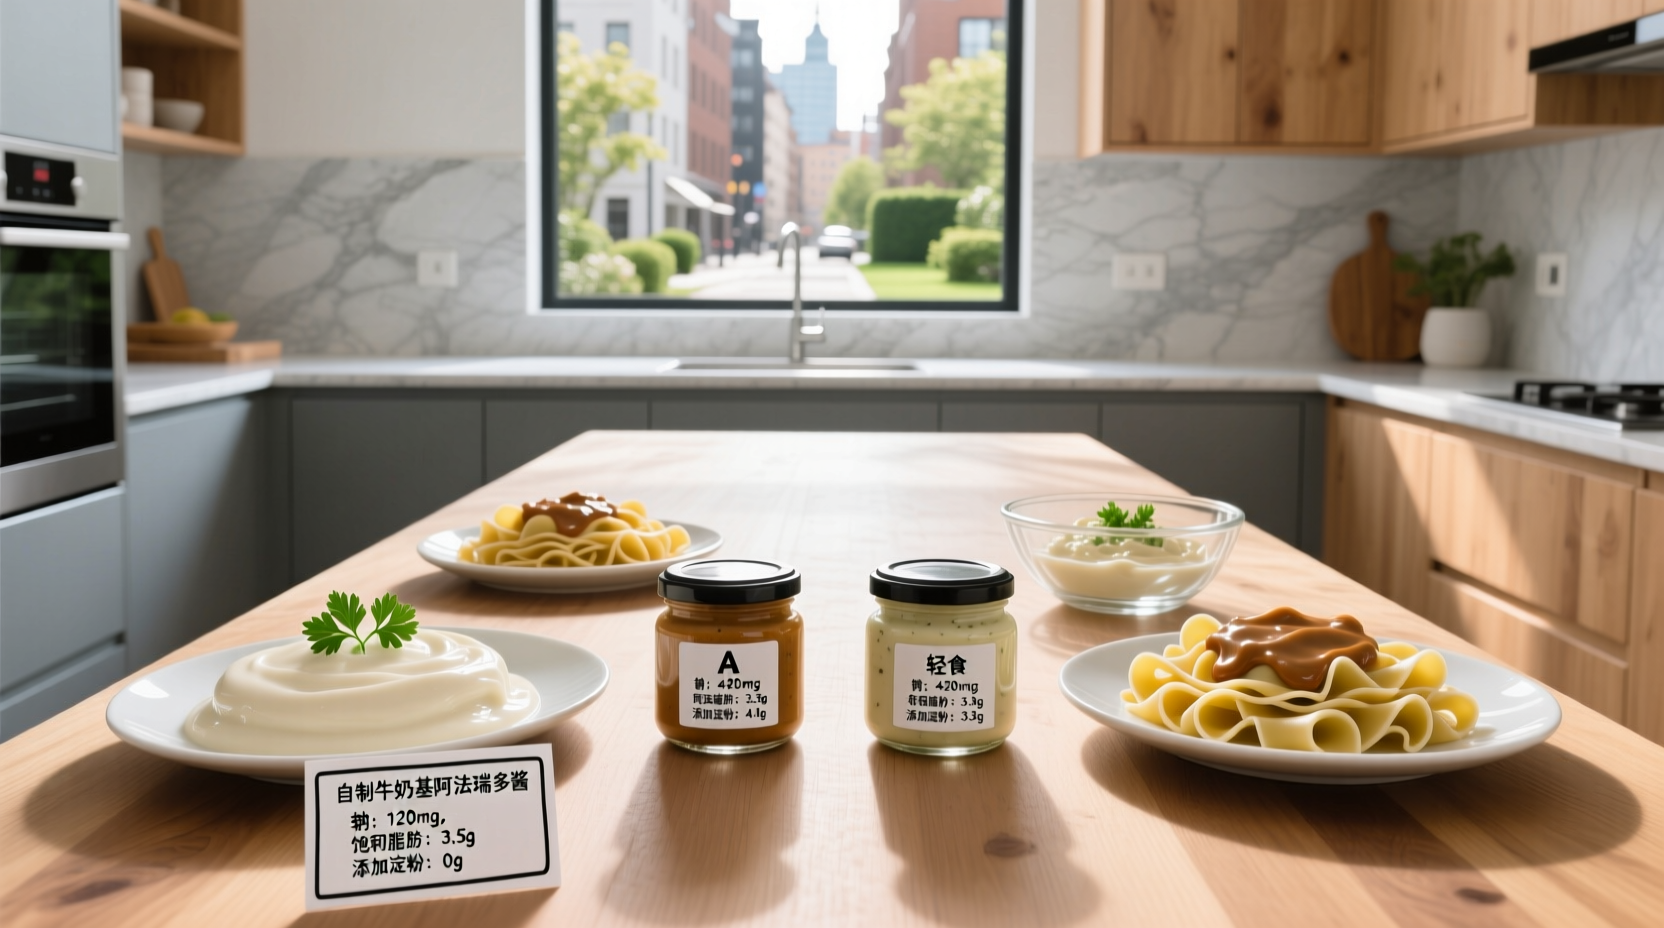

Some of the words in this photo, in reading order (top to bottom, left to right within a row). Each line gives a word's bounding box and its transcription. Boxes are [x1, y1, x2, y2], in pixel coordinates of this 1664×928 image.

[717, 650, 740, 674] A
[926, 653, 967, 676] 轻食
[338, 770, 529, 804] 自制牛奶基阿法瑞多酱
